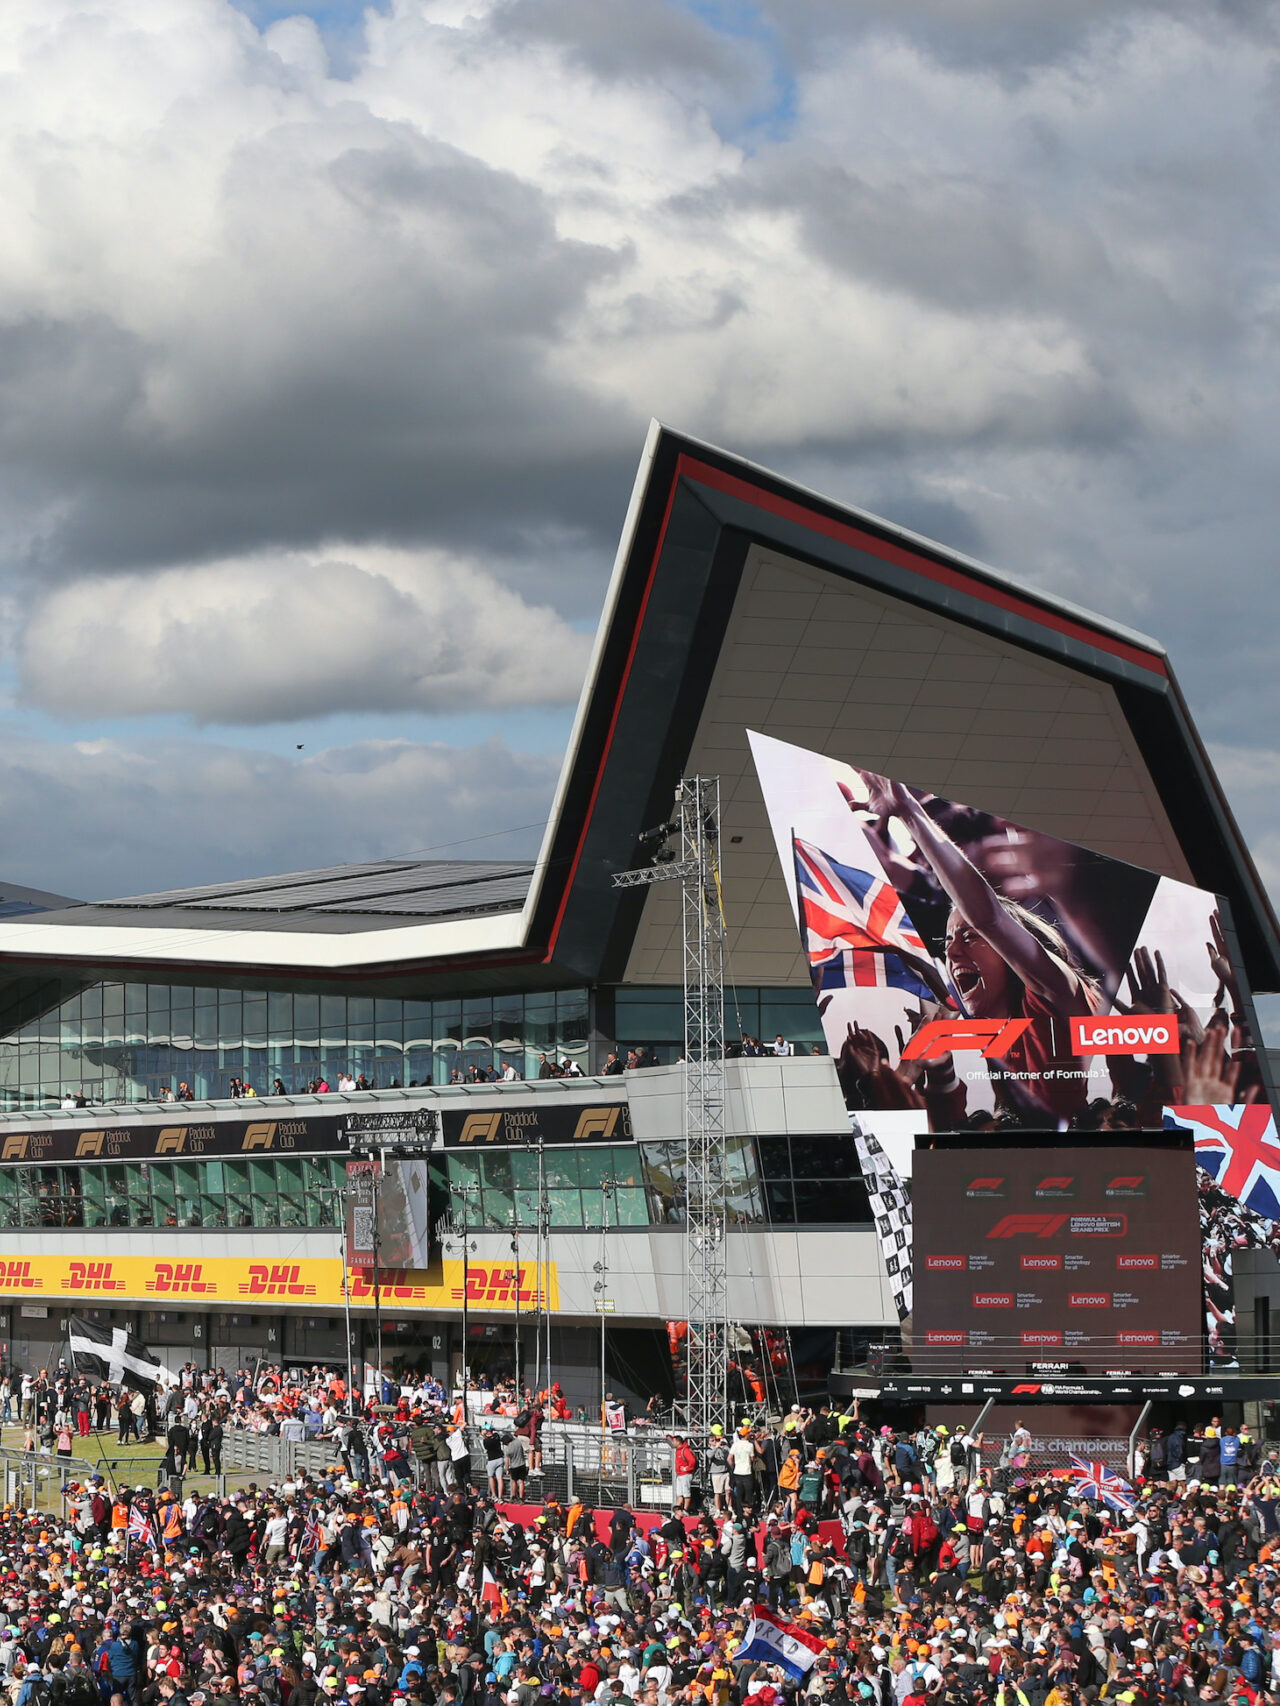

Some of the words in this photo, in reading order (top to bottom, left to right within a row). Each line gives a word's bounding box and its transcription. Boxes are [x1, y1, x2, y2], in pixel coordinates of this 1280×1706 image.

[1079, 1024, 1169, 1046] Lenovo
[966, 1070, 1001, 1080] Official
[1004, 1070, 1040, 1080] Partner
[1043, 1069, 1055, 1079] of
[1056, 1069, 1099, 1079] Formula
[504, 1111, 539, 1127] Paddock
[189, 1127, 216, 1140] Paddock
[279, 1121, 307, 1135] Paddock
[505, 1126, 523, 1141] Club
[30, 1134, 52, 1147] Paddock
[106, 1130, 131, 1143] Paddock
[280, 1134, 295, 1148] Club
[31, 1146, 43, 1158] Club
[107, 1142, 120, 1155] Club
[190, 1139, 204, 1152] Club
[928, 1258, 962, 1266] Lenovo
[1023, 1258, 1057, 1266] Lenovo
[1120, 1258, 1154, 1266] Lenovo
[69, 1262, 116, 1290] DHL
[155, 1264, 207, 1292] DHL
[249, 1265, 305, 1295] DHL
[351, 1267, 413, 1298] DHL
[466, 1268, 531, 1301] DHL
[976, 1296, 1009, 1304] Lenovo
[1071, 1296, 1106, 1304] Lenovo
[194, 1326, 201, 1337] 05
[268, 1329, 276, 1341] 04
[1023, 1334, 1057, 1342] Lenovo
[1120, 1334, 1154, 1342] Lenovo
[432, 1336, 441, 1349] 02
[1032, 1362, 1068, 1370] FERRARI
